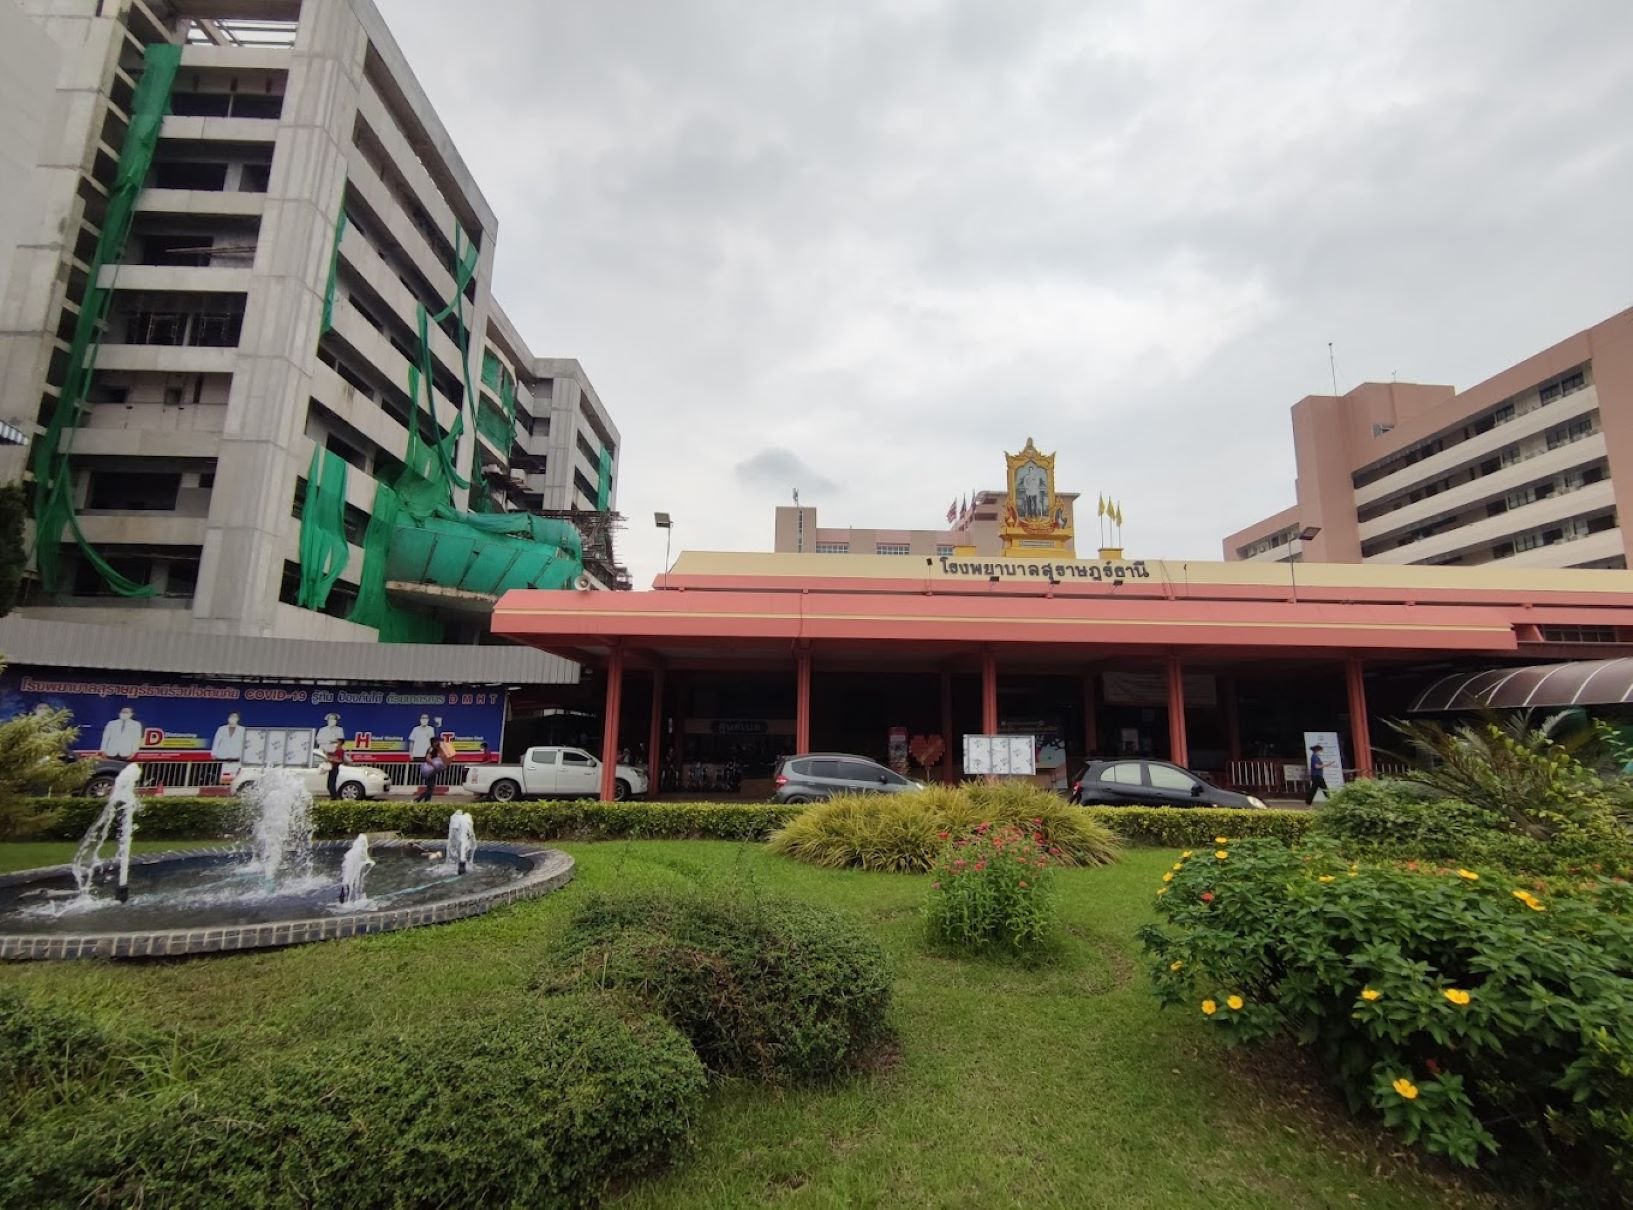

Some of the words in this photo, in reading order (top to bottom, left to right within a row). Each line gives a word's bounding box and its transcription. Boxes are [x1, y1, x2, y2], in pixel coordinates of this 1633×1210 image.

[940, 557, 1150, 581] โรงพยาบาลสุราษฎร์ธานี
[244, 688, 307, 702] COVID-19
[448, 693, 458, 704] D
[462, 693, 473, 704] M
[476, 694, 486, 704] H
[489, 694, 498, 704] T
[144, 727, 165, 747] D
[355, 731, 372, 749] H
[440, 731, 455, 744] T
